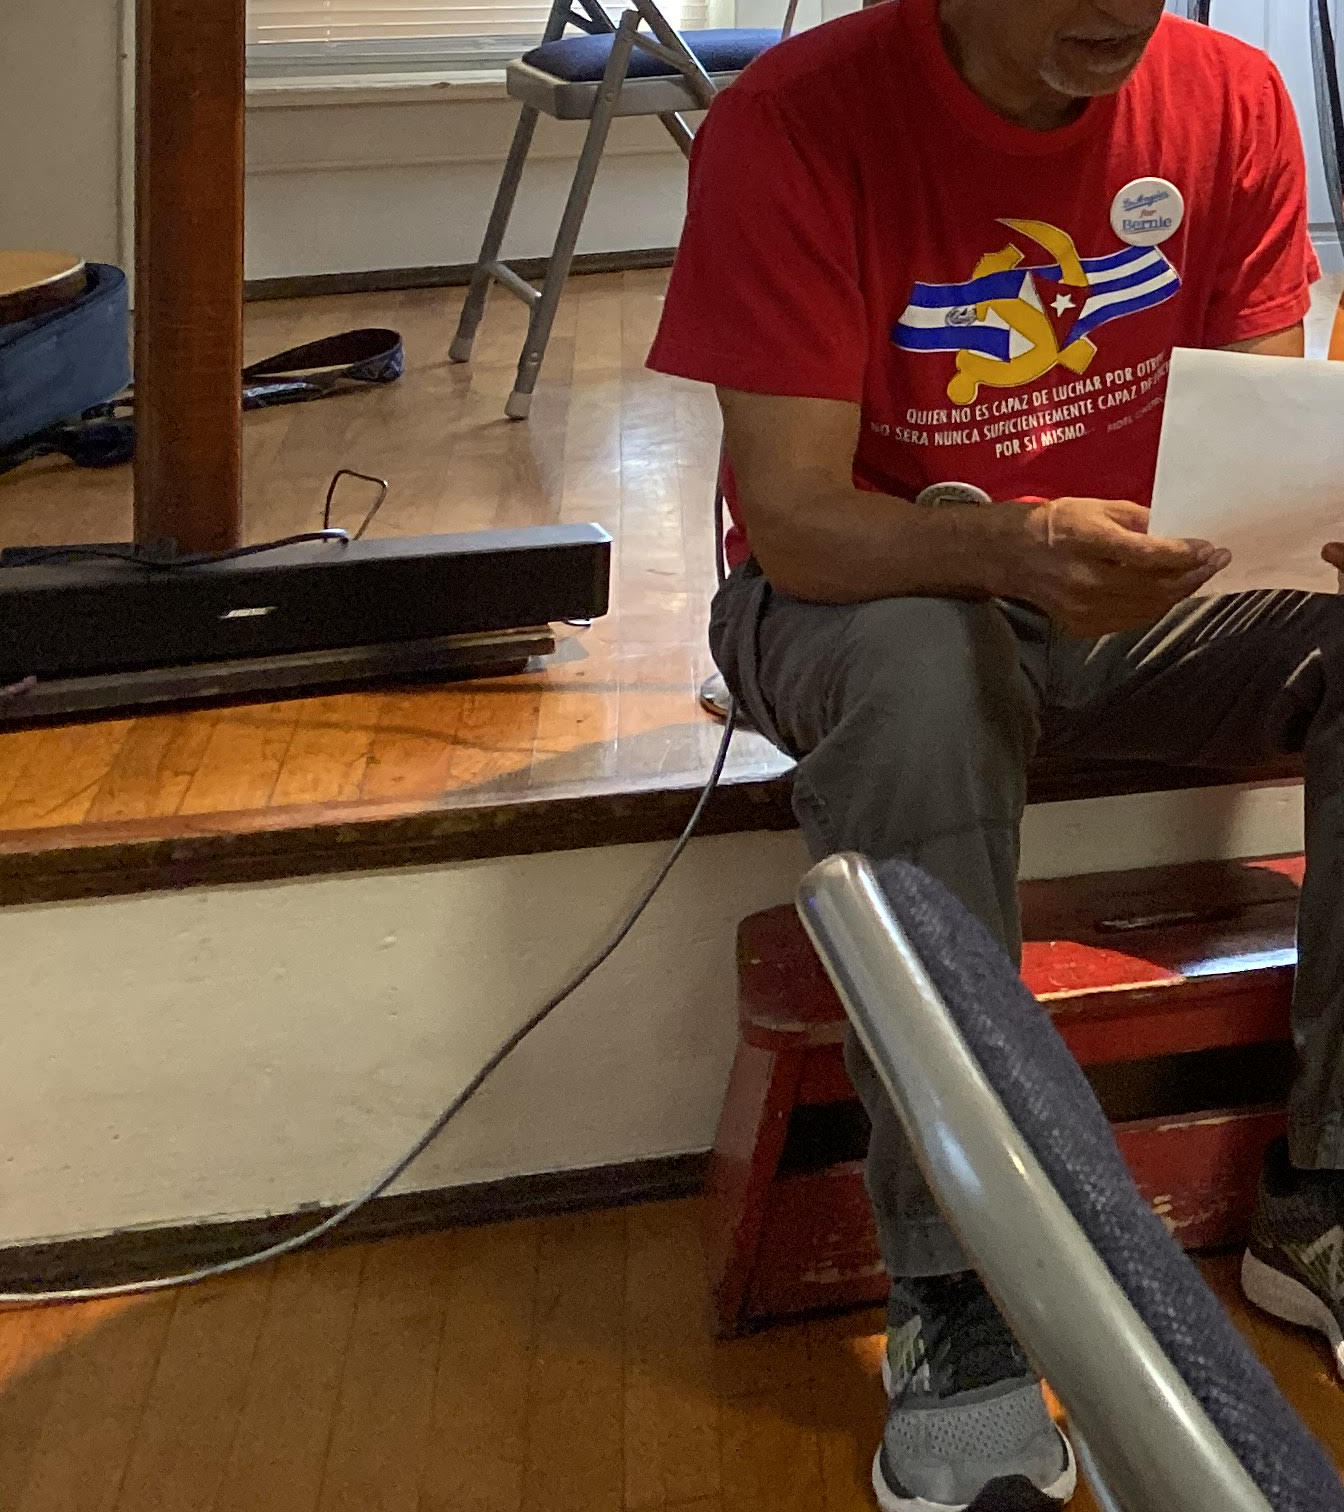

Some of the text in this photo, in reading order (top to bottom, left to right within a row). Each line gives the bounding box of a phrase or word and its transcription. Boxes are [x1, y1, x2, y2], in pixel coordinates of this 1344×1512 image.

[1123, 216, 1171, 232] Bernie
[906, 409, 947, 425] QUIEN
[952, 408, 971, 424] NO
[976, 404, 989, 420] ES
[993, 394, 1028, 416] CAPAZ
[1033, 390, 1049, 406] DE
[1052, 376, 1102, 402] LUCHAR
[1106, 368, 1133, 387] POR
[935, 428, 980, 446] NUNCA
[984, 399, 1094, 440] SUFICIENTEMENTE
[1098, 385, 1137, 409] CAPAZ
[995, 439, 1021, 458] POR
[1024, 435, 1037, 451] SI
